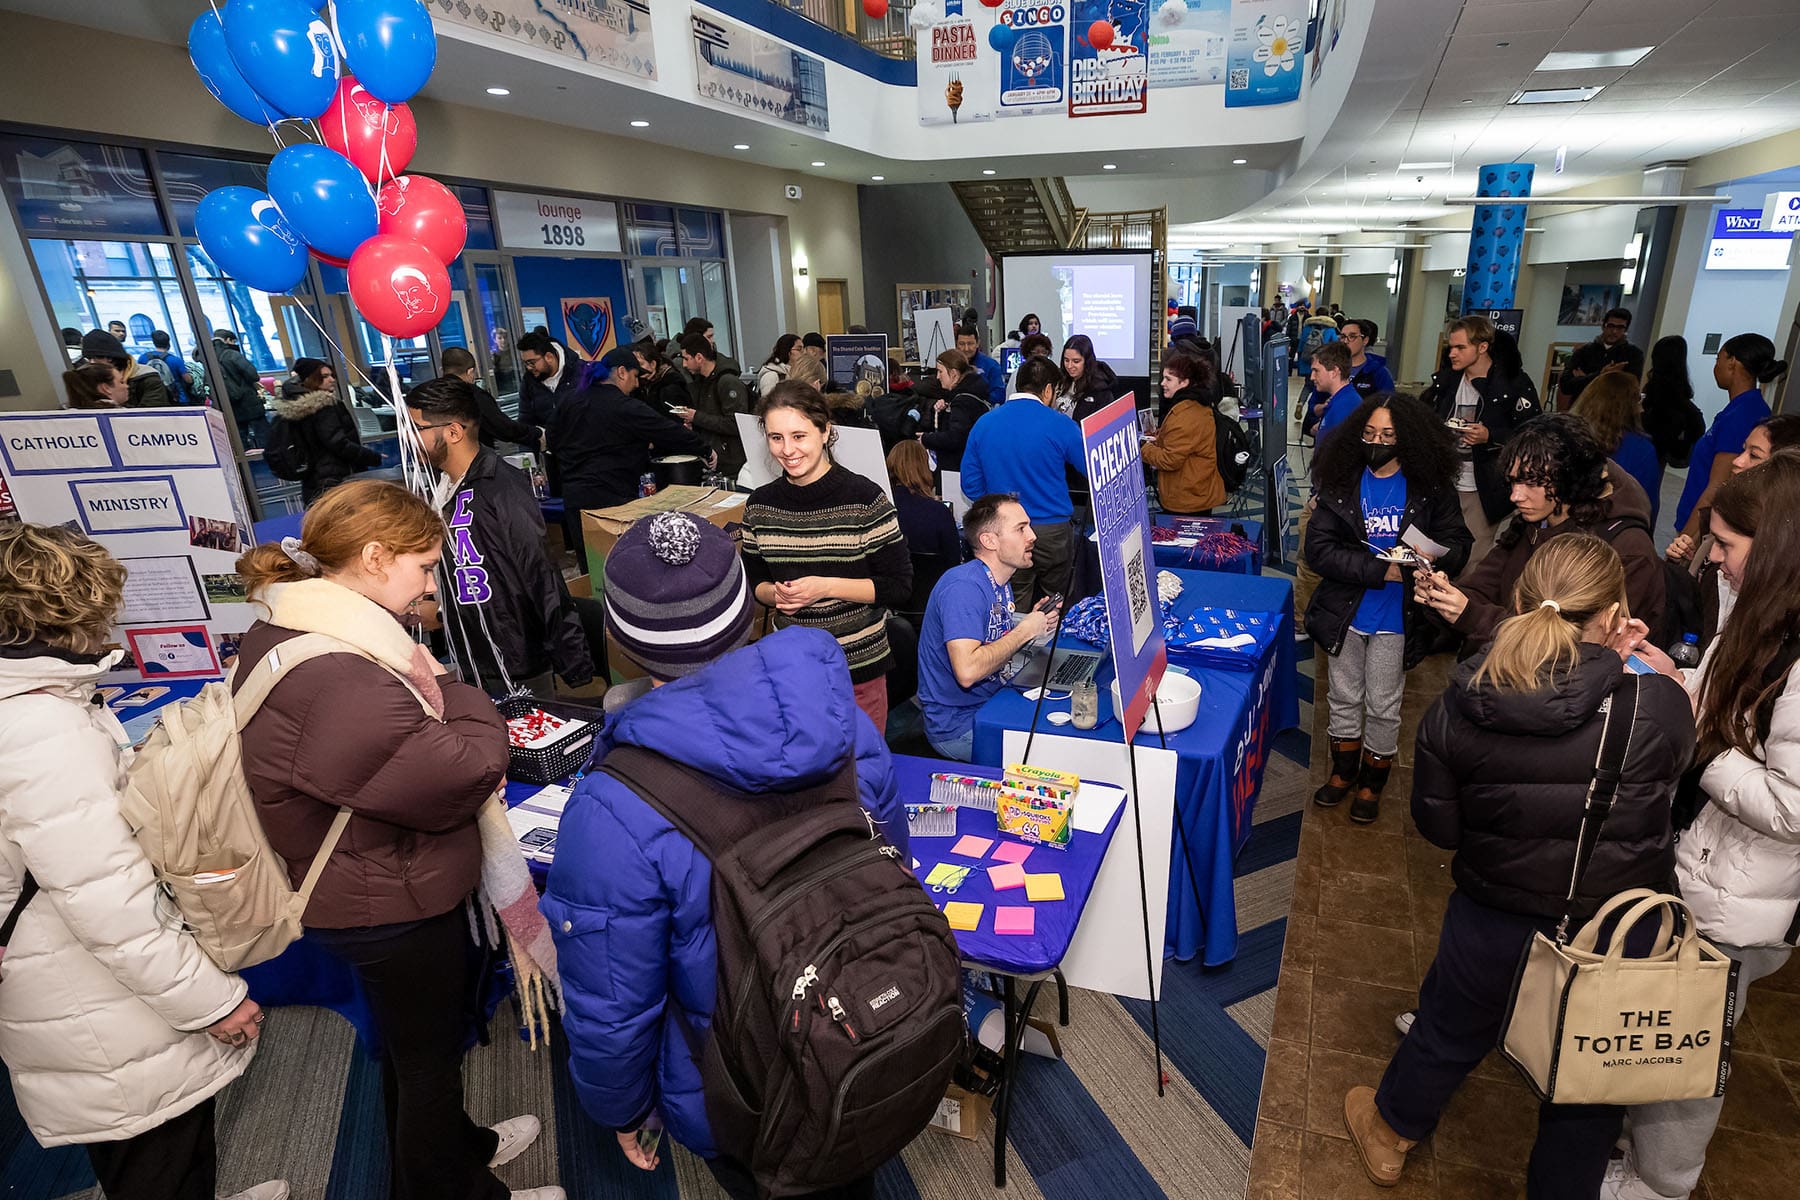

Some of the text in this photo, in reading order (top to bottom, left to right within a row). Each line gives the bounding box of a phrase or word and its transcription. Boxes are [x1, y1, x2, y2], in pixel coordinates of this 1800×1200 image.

[1002, 9, 1063, 25] BINGO
[932, 25, 976, 45] PASTA
[931, 45, 977, 63] DINNER
[1073, 58, 1105, 82] DIBS
[1073, 79, 1144, 105] BIRTHDAY
[537, 200, 582, 223] lounge
[1725, 215, 1761, 229] WINT
[541, 223, 585, 246] 1898
[1489, 310, 1501, 320] ID
[1493, 321, 1515, 332] ices
[11, 433, 198, 451] CATHOLIC CAMPUS
[1090, 420, 1139, 492] CHECK IN
[88, 497, 169, 512] MINISTRY
[1364, 515, 1403, 534] PAU
[1021, 766, 1061, 779] Crayola
[1022, 822, 1040, 837] 64
[1619, 1010, 1672, 1028] THE
[1573, 1029, 1711, 1054] TOTE BAG
[1602, 1056, 1683, 1068] MARC JACOBS
